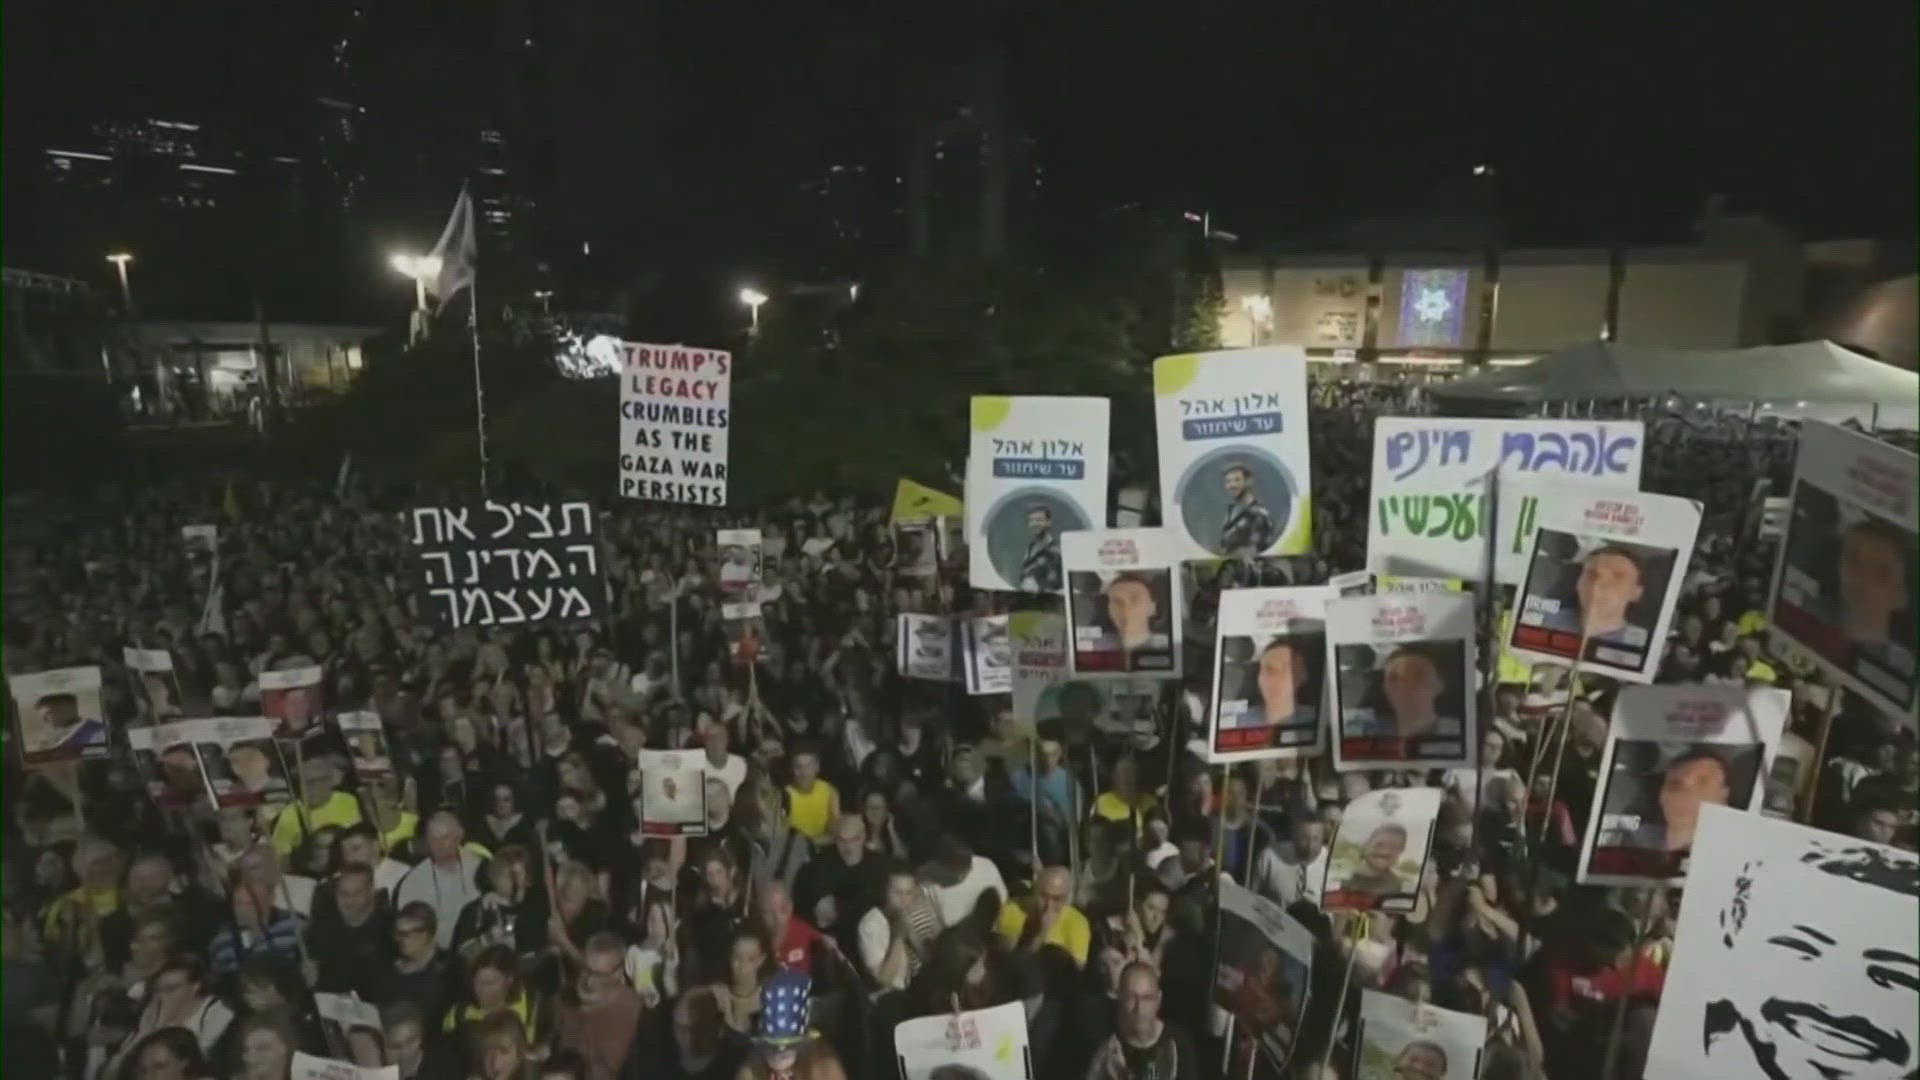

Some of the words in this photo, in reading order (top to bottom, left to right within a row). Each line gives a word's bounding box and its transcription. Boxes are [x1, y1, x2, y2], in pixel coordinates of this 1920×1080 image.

[624, 346, 728, 374] TRUMP'S
[632, 375, 719, 400] LEGACY
[622, 400, 728, 429] CRUMBLES
[1179, 397, 1224, 415] אהל
[1234, 392, 1280, 416] אלון
[1251, 417, 1274, 432] עד
[635, 429, 661, 448] AS
[671, 431, 712, 452] THE
[992, 437, 1032, 456] אהל
[1040, 440, 1084, 460] אלון
[621, 454, 674, 476] GAZA
[682, 459, 726, 480] WAR
[1386, 429, 1472, 482] חינם
[1057, 465, 1077, 477] עד
[623, 478, 723, 504] PERSISTS
[412, 504, 476, 545] את
[484, 499, 593, 540] תציל
[421, 545, 596, 585] המדינה
[429, 585, 592, 629] מעצמך
